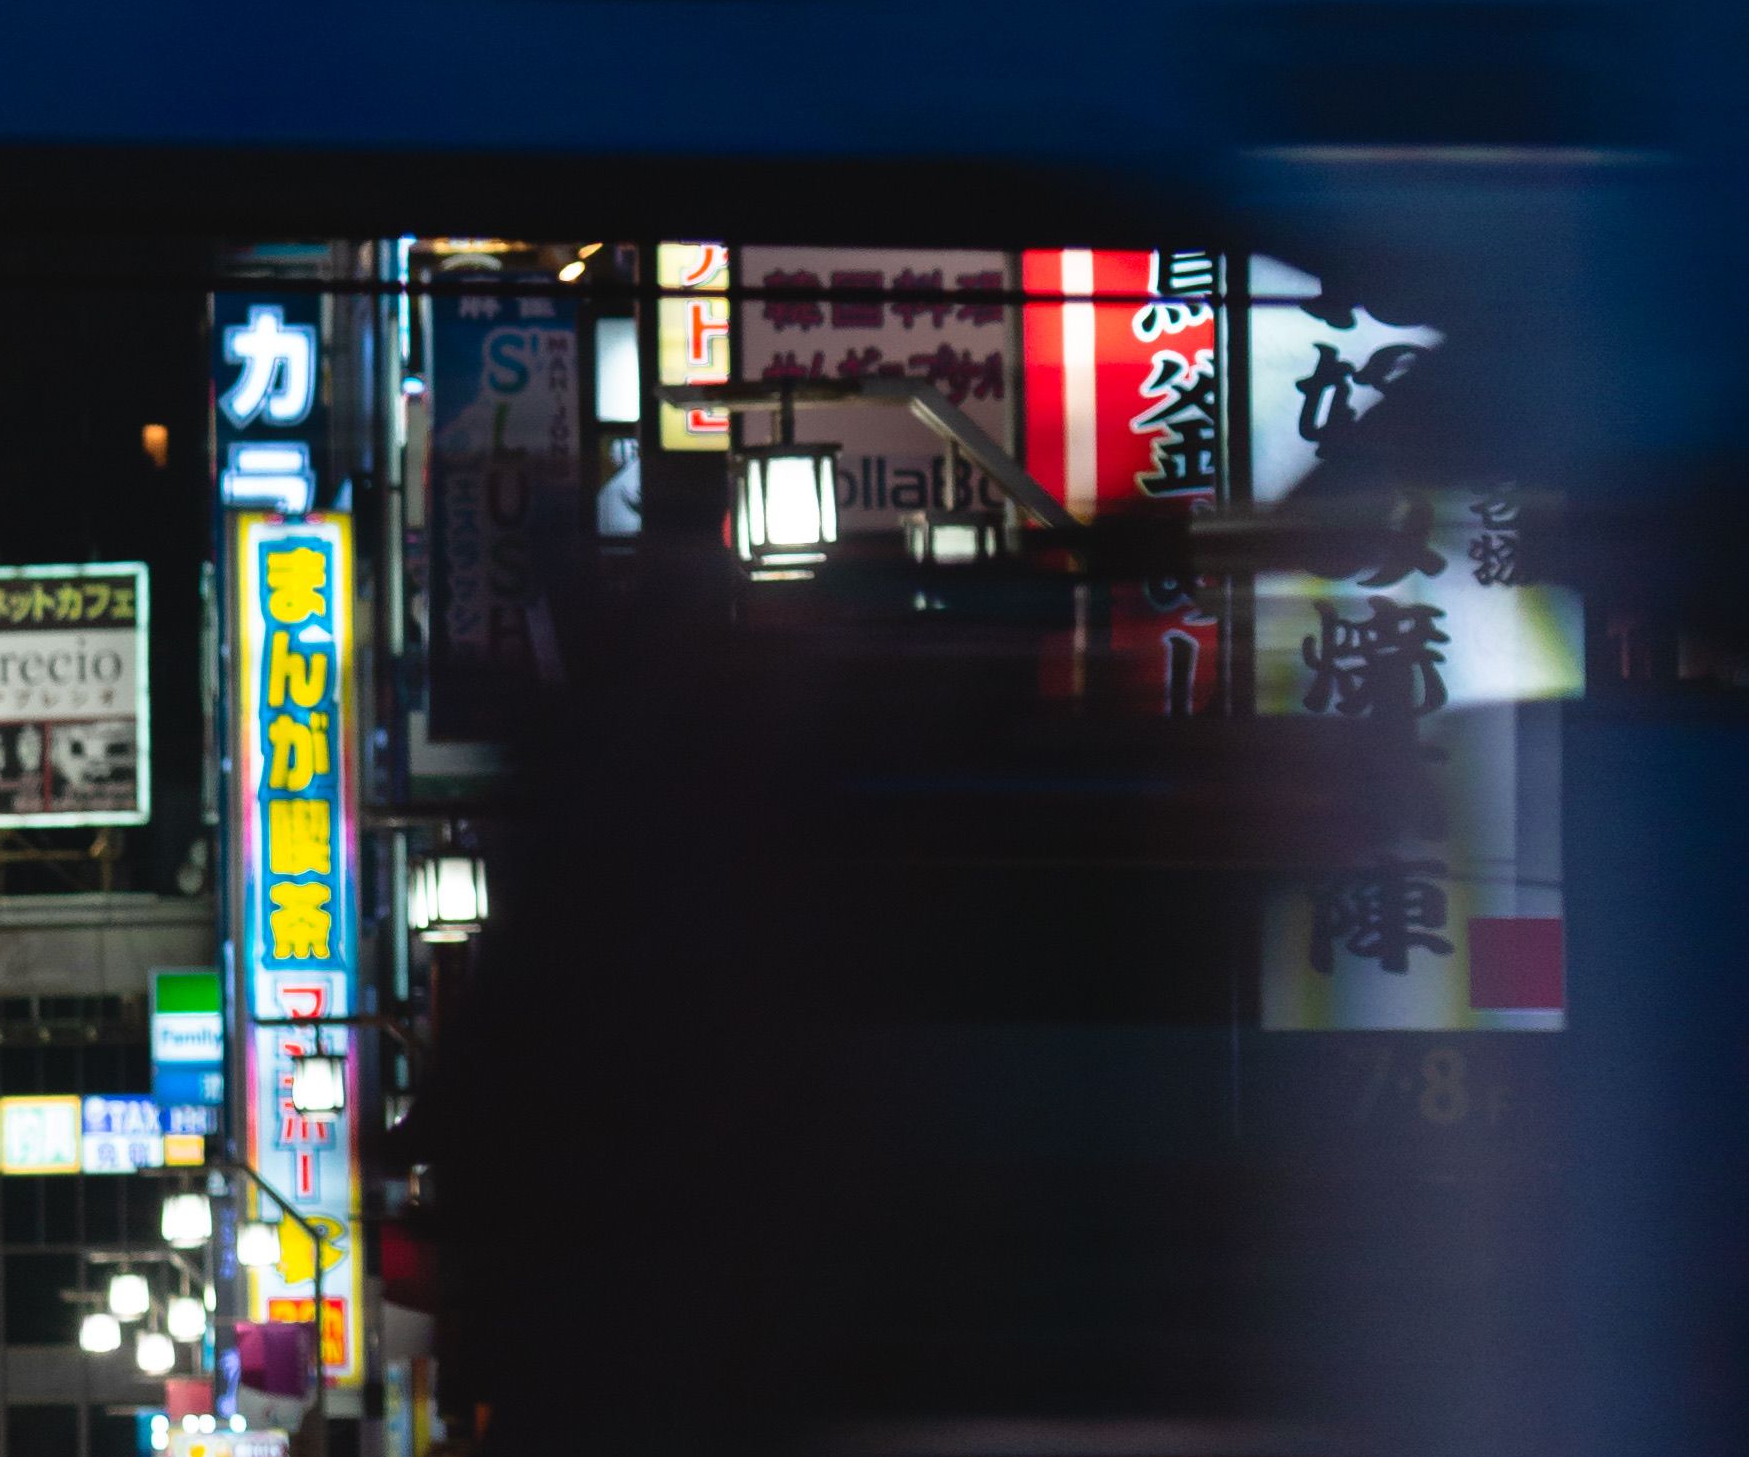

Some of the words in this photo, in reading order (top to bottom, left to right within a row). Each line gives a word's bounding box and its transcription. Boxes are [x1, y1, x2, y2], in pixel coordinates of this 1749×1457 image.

[266, 548, 333, 959] まんが喫茶
